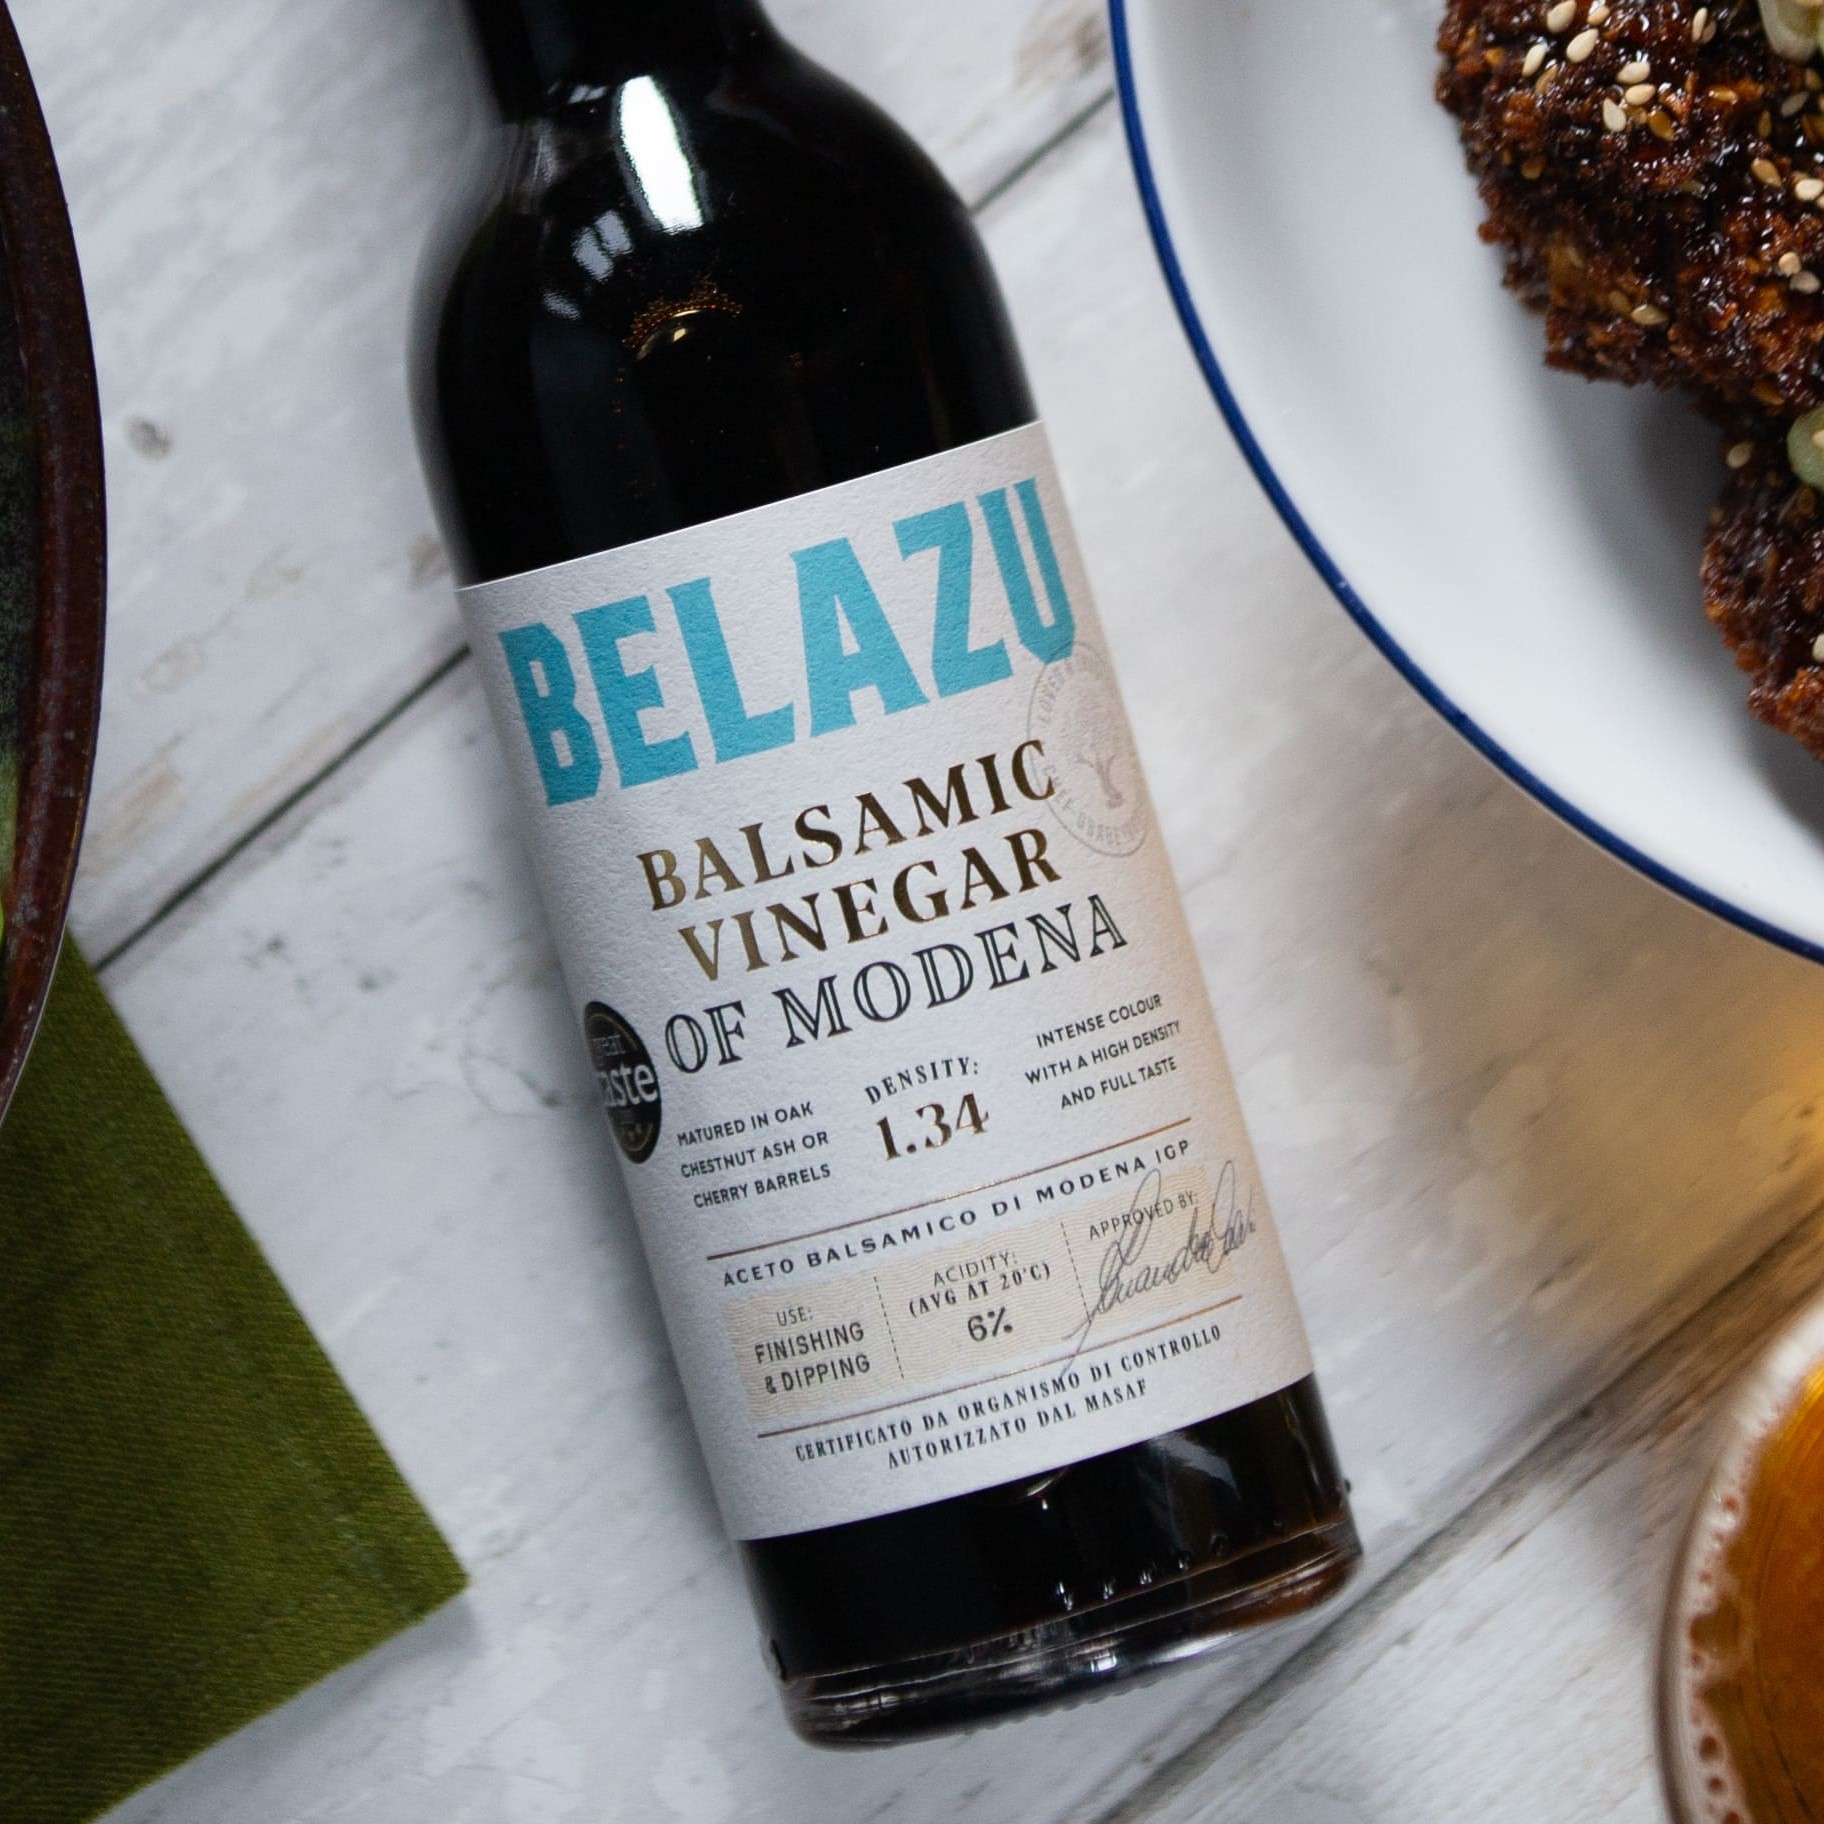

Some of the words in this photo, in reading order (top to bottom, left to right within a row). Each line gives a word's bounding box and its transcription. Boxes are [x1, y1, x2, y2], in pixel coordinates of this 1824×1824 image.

[499, 477, 1076, 807] BELAZU
[637, 739, 1056, 911] BALSAMIC
[679, 828, 1062, 981] VINEGAR
[664, 999, 746, 1074] OF
[772, 894, 1128, 1047] MODENA
[1036, 1014, 1106, 1048] INTENSE
[1109, 994, 1163, 1024] COLOUR
[1025, 1060, 1073, 1086] WITH
[1077, 1055, 1089, 1069] A
[1092, 1040, 1130, 1064] HIGH
[1133, 1020, 1181, 1051] DENSITY
[864, 1056, 979, 1105] DENSITY:
[1061, 1086, 1096, 1110] AND
[1101, 1071, 1137, 1096] FULL
[1138, 1056, 1177, 1082] TASTE
[677, 1119, 746, 1146] MATURED
[751, 1113, 769, 1129] IN
[775, 1101, 814, 1123] OAK
[876, 1092, 989, 1161] 1.34
[680, 1148, 755, 1178] CHESTNUT
[762, 1139, 796, 1160] ASH
[802, 1131, 829, 1149] OR
[693, 1183, 748, 1208] CHERRY
[754, 1163, 831, 1195] BARRELS
[723, 1259, 794, 1287] ACETO
[806, 1209, 977, 1268] BALSAMICO
[991, 1196, 1021, 1217] DI
[1035, 1156, 1145, 1204] MODENA
[1155, 1140, 1190, 1164] IGP
[1089, 1198, 1174, 1241] APPROVED
[1178, 1190, 1199, 1209] BY:
[933, 1251, 1018, 1288] ACIDITY:
[776, 1307, 813, 1327] USE:
[909, 1288, 957, 1318] (AVG
[967, 1279, 989, 1300] AT
[967, 1307, 1013, 1342] 6%
[754, 1322, 864, 1364] FINISHING
[765, 1375, 777, 1394] &
[780, 1354, 870, 1392] DIPPING
[795, 1420, 913, 1463] CERTIFICATO
[922, 1411, 949, 1432] DA
[957, 1373, 1081, 1423] ORGANISMO
[1089, 1364, 1113, 1382] DI
[1120, 1324, 1222, 1373] CONTROLLO
[888, 1417, 1028, 1470] AUTORIZZATO
[1037, 1405, 1077, 1428] DAL
[1084, 1378, 1148, 1414] MASAF
